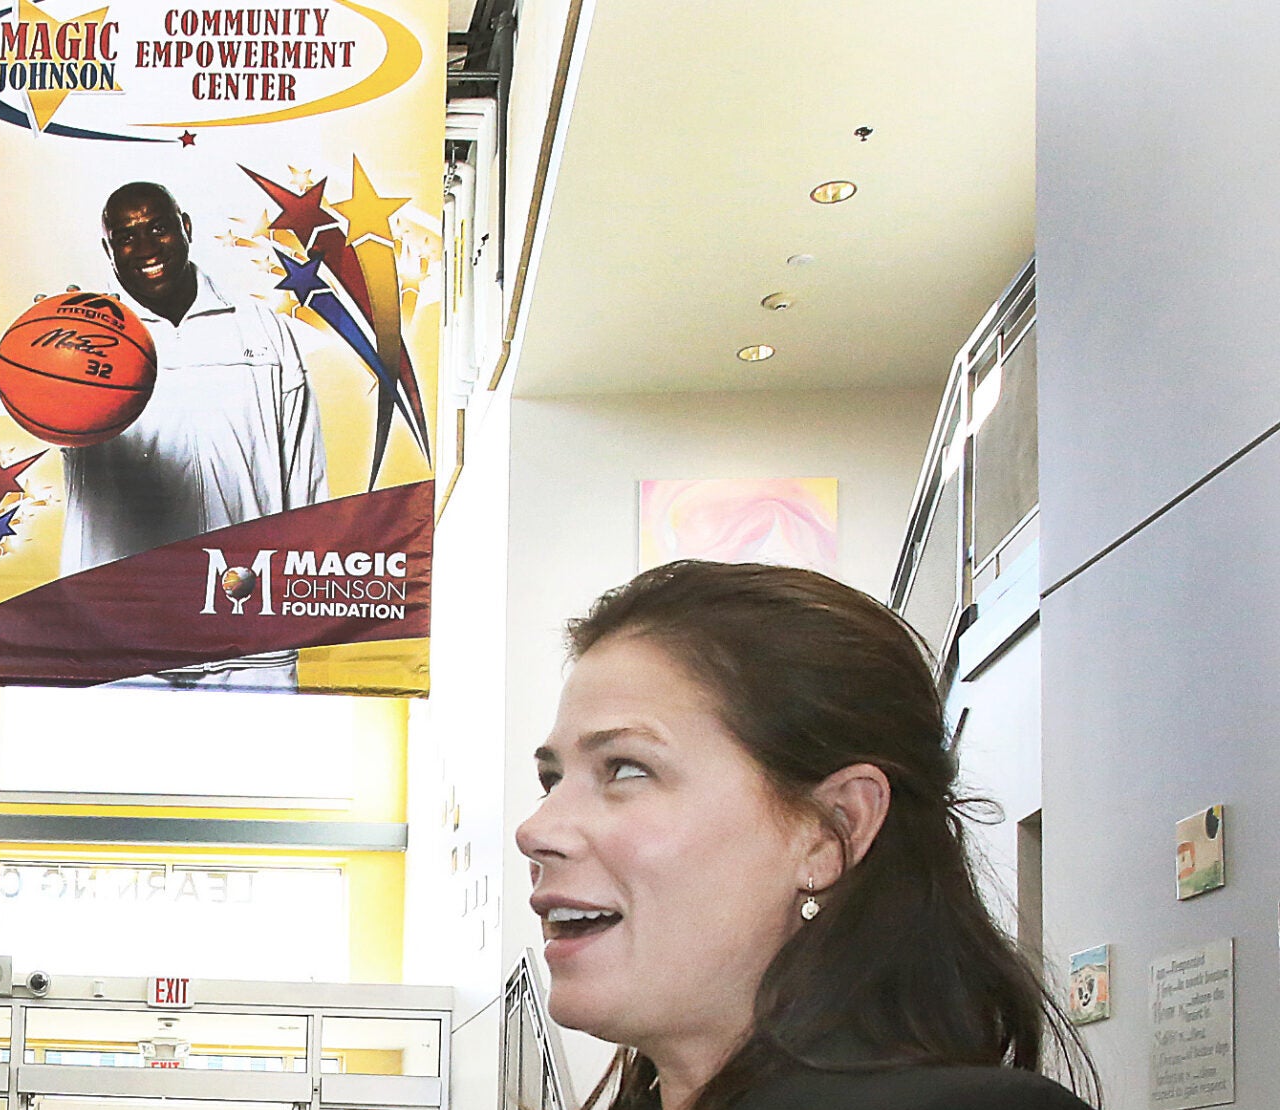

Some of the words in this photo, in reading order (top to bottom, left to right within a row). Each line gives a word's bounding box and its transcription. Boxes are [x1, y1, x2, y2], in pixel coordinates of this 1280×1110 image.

[164, 8, 331, 37] COMMUNITY
[0, 21, 119, 61] MAGIC
[135, 40, 356, 69] EMPOWERMENT
[191, 73, 297, 102] CENTER
[85, 359, 114, 380] 32
[283, 550, 407, 578] MAGIC
[283, 579, 406, 600] JOHNSON
[282, 602, 405, 620] FOUNDATION
[155, 977, 189, 1004] EXIT
